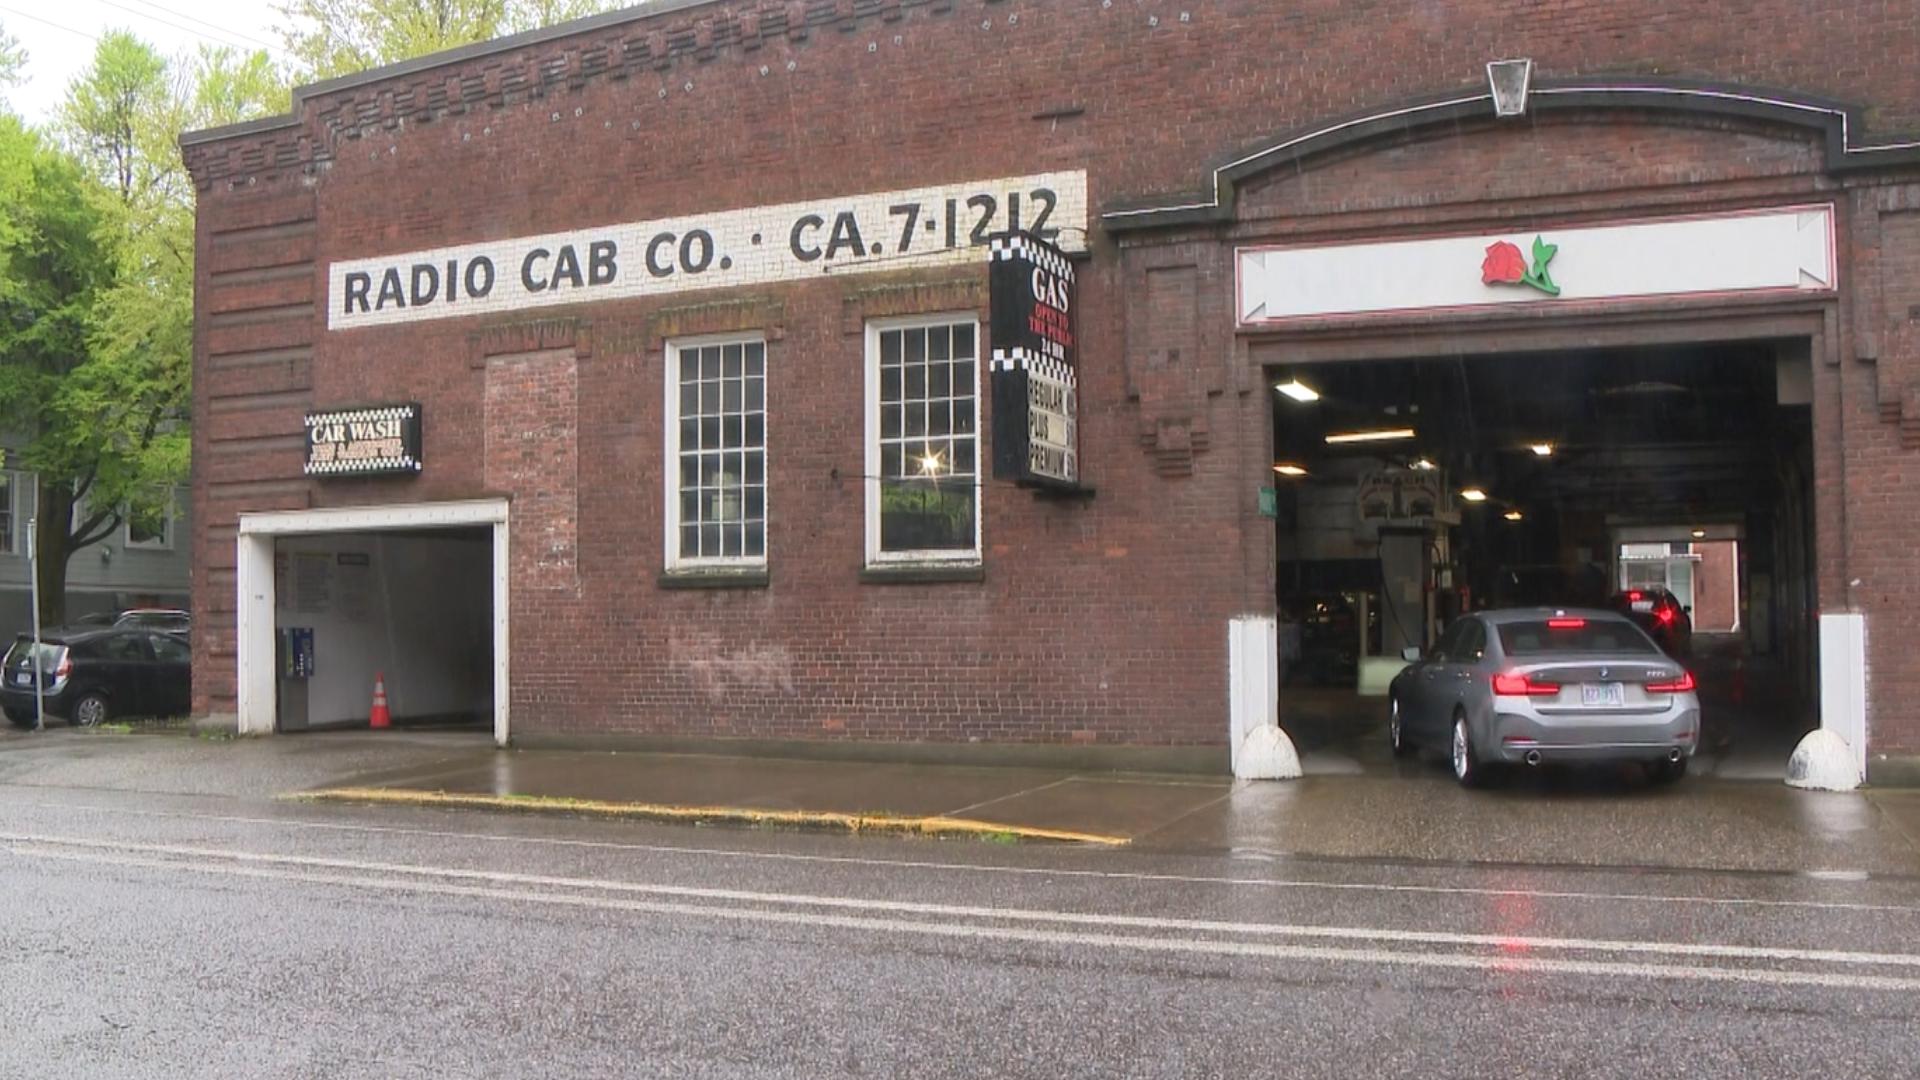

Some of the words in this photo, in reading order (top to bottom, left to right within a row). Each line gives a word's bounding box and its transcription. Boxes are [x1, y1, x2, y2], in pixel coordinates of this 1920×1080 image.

[344, 255, 495, 313] RADIO
[521, 240, 618, 294] CAB
[644, 229, 732, 277] CO.
[1032, 266, 1069, 313] GAS
[1028, 315, 1046, 334] THE
[1047, 324, 1073, 347] PUBLIC
[1035, 302, 1058, 323] OPEN
[1059, 313, 1069, 330] TO
[1029, 379, 1062, 412] REGULAR
[311, 424, 346, 444] CAR
[350, 420, 401, 440] WASH
[1029, 411, 1049, 441] PLUS
[1029, 442, 1065, 479] PREMIUM
